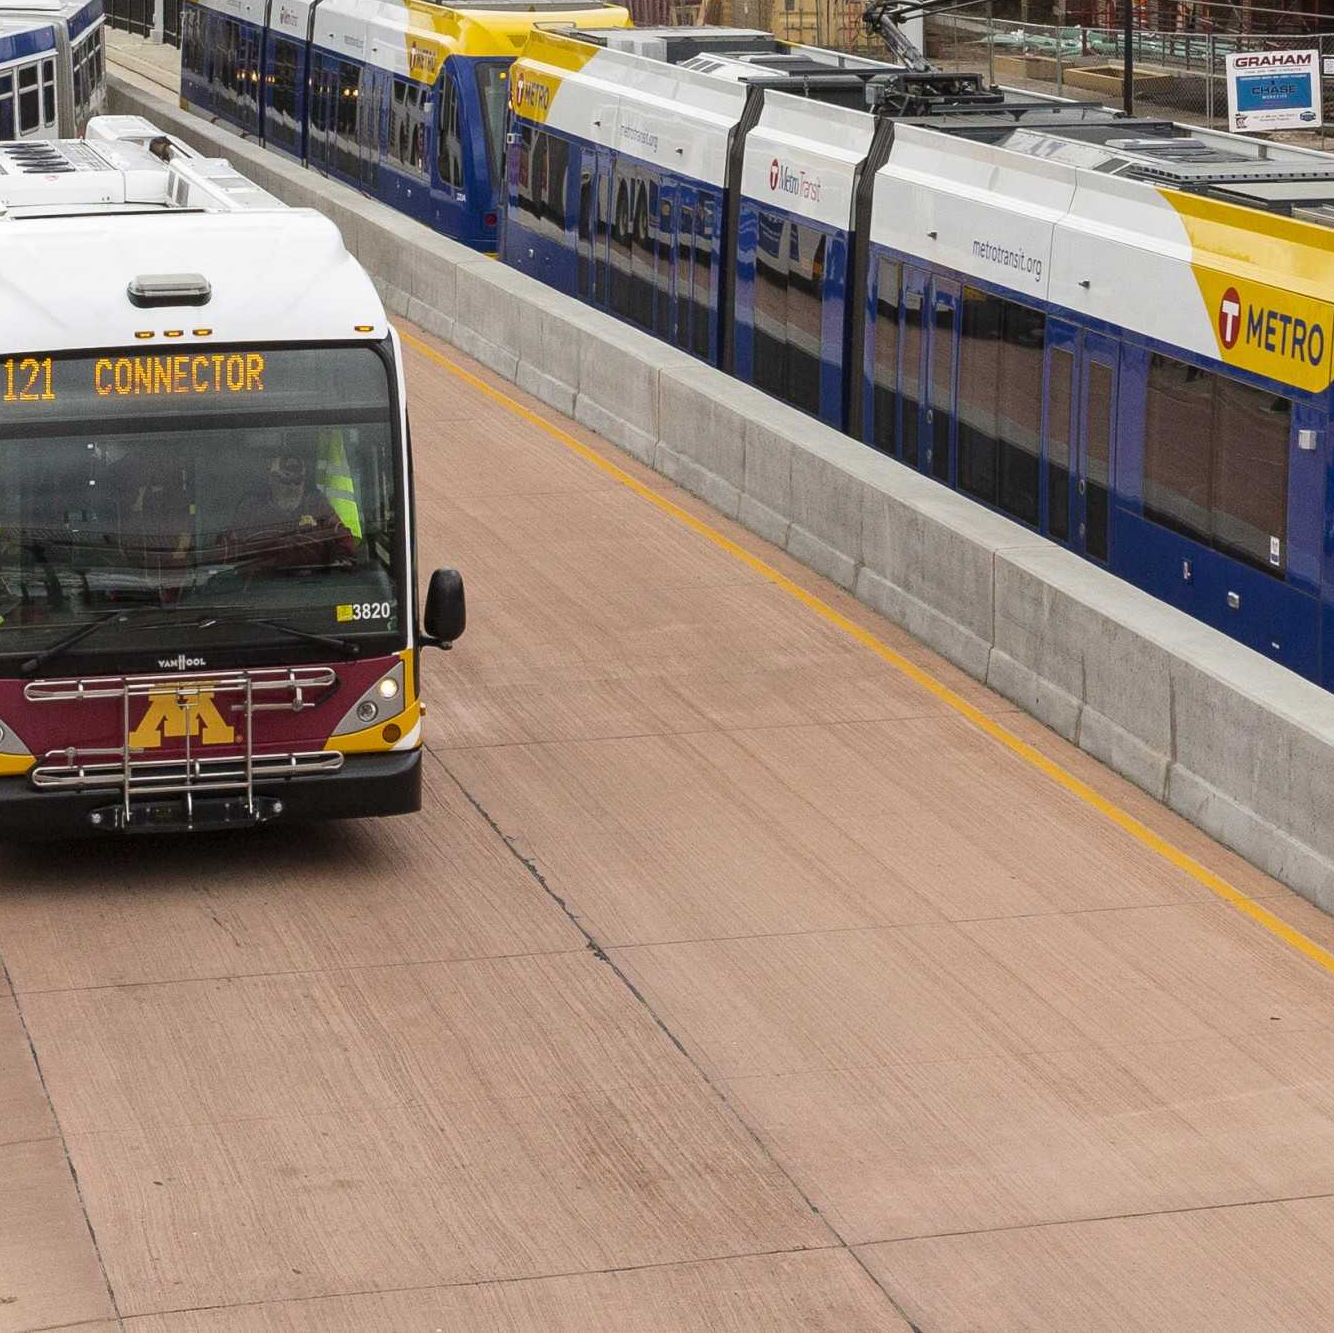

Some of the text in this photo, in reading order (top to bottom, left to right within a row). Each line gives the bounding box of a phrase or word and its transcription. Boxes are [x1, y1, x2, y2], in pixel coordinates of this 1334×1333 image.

[1235, 54, 1312, 68] GRAHAM
[525, 82, 550, 110] METRO
[1251, 84, 1297, 95] CHASE
[971, 239, 1043, 283] metrotransit.org
[1245, 303, 1325, 367] METRO
[3, 353, 265, 401] 121 CONNECTOR
[353, 602, 390, 620] 3820
